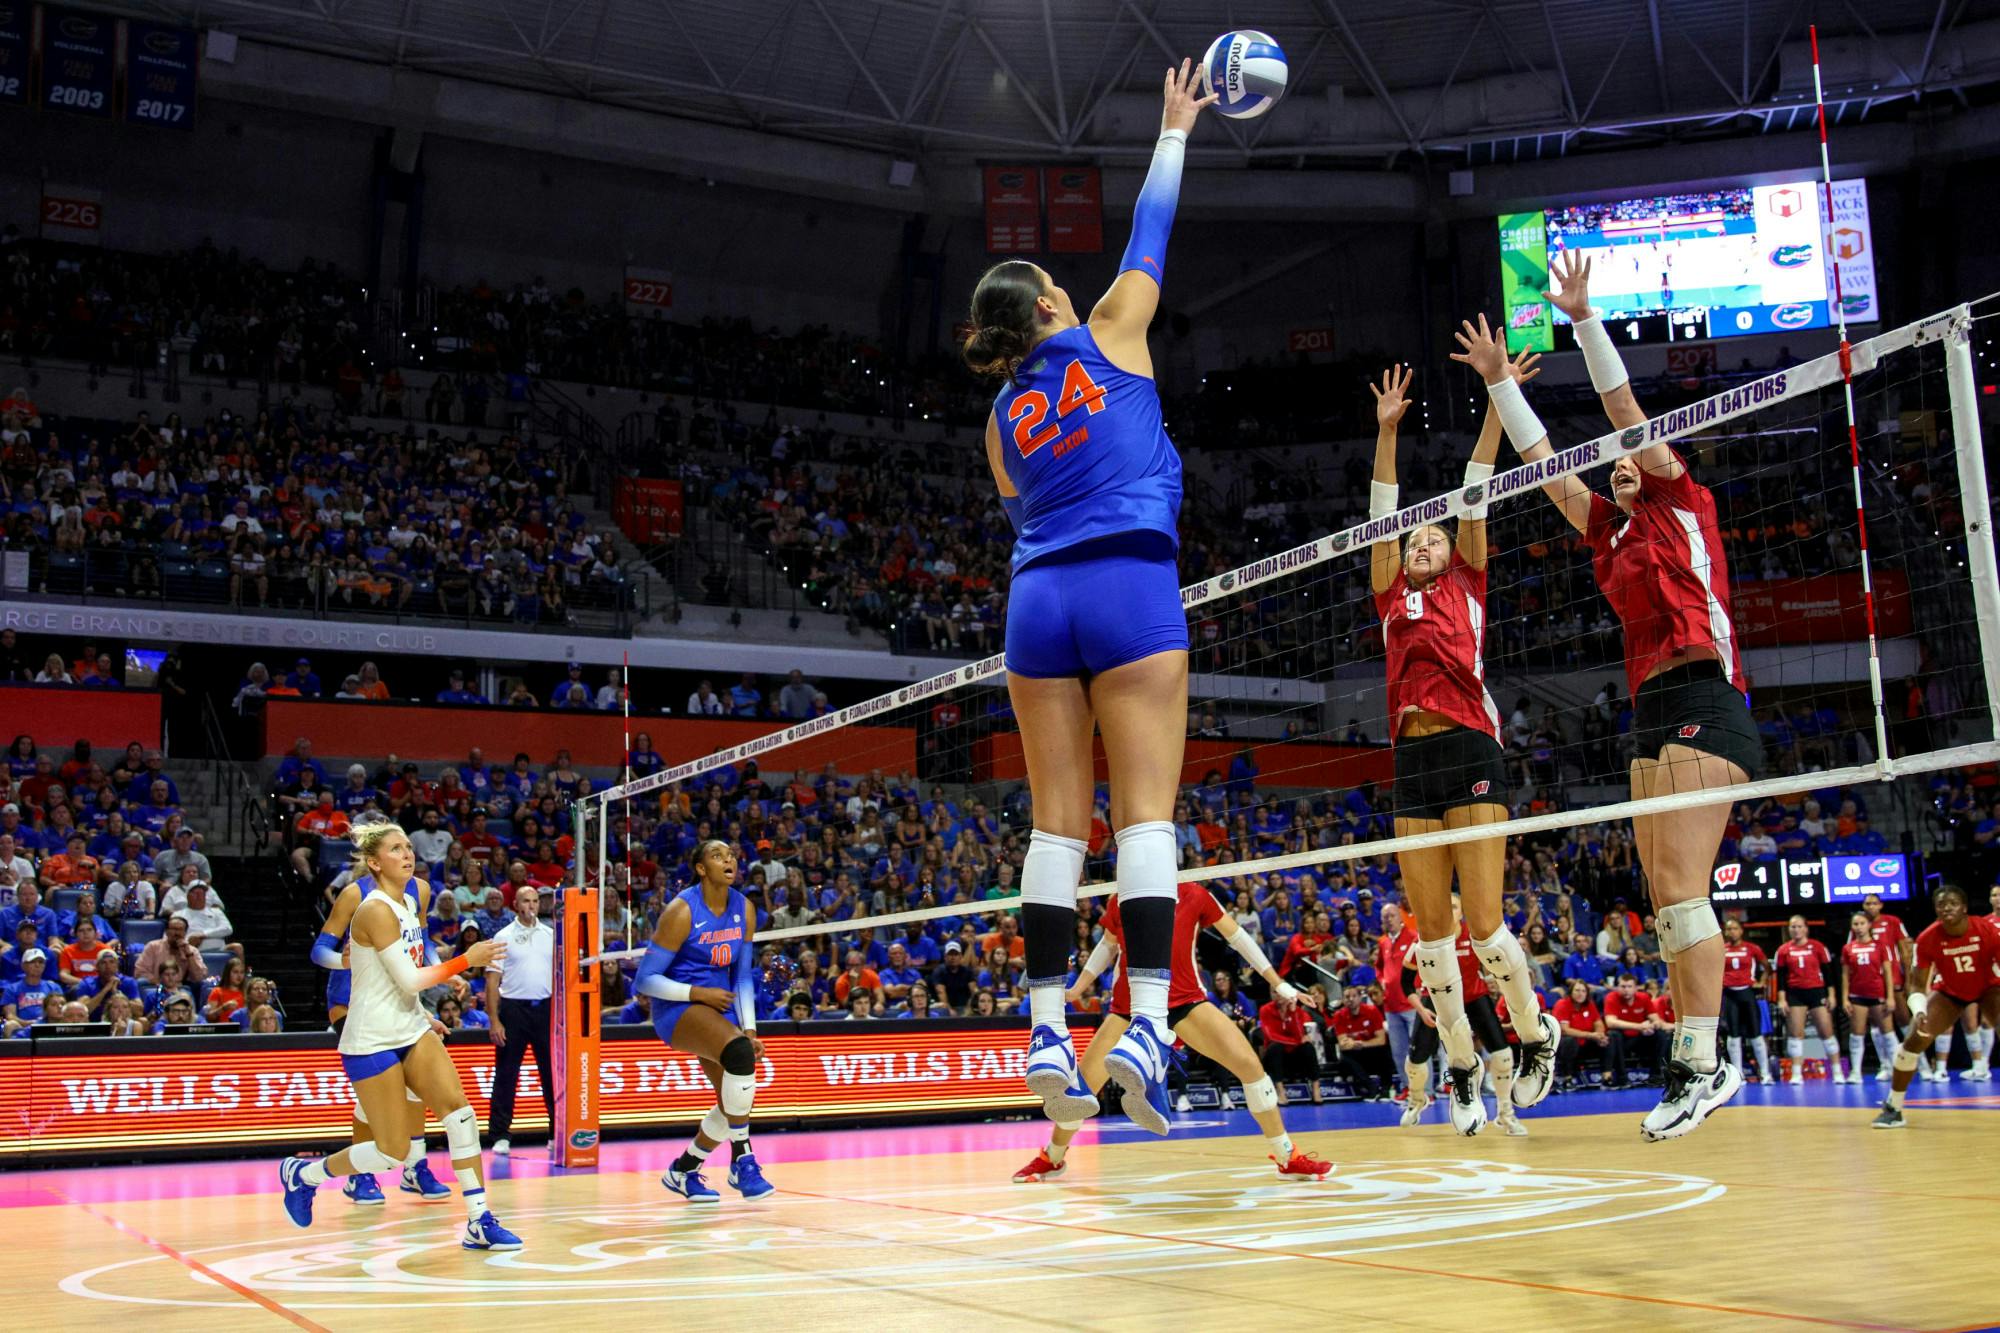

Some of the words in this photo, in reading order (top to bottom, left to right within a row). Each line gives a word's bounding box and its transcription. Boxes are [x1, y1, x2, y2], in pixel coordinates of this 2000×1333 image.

[1228, 42, 1242, 91] molten
[49, 85, 104, 109] 2003
[135, 99, 187, 122] 2017
[47, 201, 98, 226] 226
[630, 282, 669, 303] 227
[1672, 309, 1705, 325] SET
[1736, 311, 1754, 330] 0
[1295, 331, 1329, 350] 201
[1626, 321, 1640, 340] 1
[1008, 358, 1108, 460] 24
[1650, 397, 1717, 441] FLORIDA
[1720, 373, 1787, 414] GATORS
[1489, 462, 1544, 498] FLORIDA
[1546, 442, 1600, 477] GATORS
[1353, 514, 1399, 546] FLORIDA
[1401, 498, 1448, 528] GATORS
[1238, 558, 1278, 585] FLORIDA
[1280, 543, 1318, 570] GATORS
[1181, 582, 1208, 604] ATORS
[1405, 592, 1424, 620] 9
[0, 610, 57, 629] RGE
[171, 621, 270, 644] CENTER
[283, 627, 363, 645] COURT
[376, 632, 436, 650] CLUB
[976, 656, 1003, 677] FLORIDA
[909, 681, 933, 699] FLORIDA
[934, 672, 957, 691] GATORS
[1754, 867, 1767, 884] 1
[1789, 863, 1821, 876] SET
[1844, 863, 1861, 880] 0
[1712, 891, 1737, 901] SETS
[1738, 890, 1762, 899] WON
[1767, 888, 1777, 899] 2
[1799, 882, 1814, 898] 5
[1834, 886, 1860, 895] SETS
[1860, 885, 1885, 894] WON
[1890, 883, 1900, 894] 2
[698, 927, 743, 945] FLORIDA
[711, 944, 732, 967] 10
[1953, 955, 1977, 973] 12
[820, 1050, 951, 1085] WELLS
[958, 1048, 1028, 1079] FAR
[61, 1074, 241, 1113] WELLS
[255, 1071, 358, 1106] FAR
